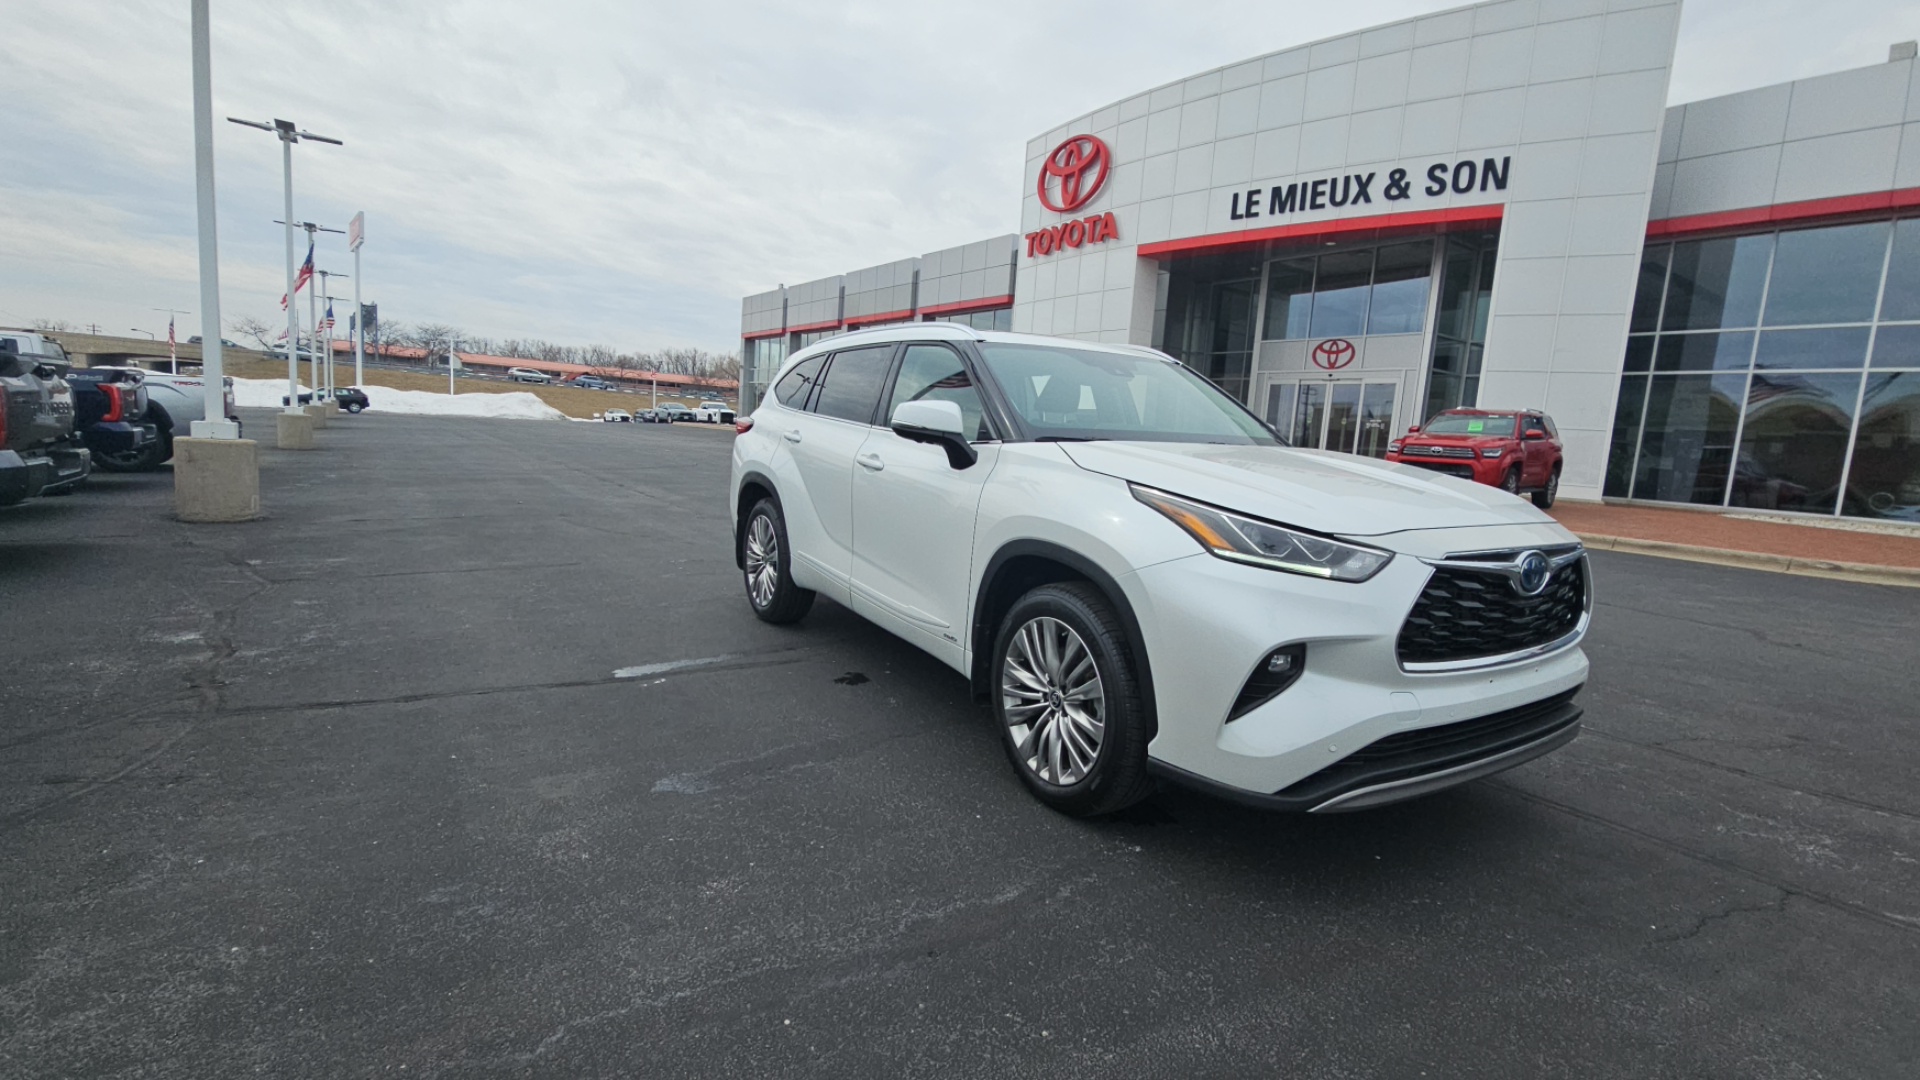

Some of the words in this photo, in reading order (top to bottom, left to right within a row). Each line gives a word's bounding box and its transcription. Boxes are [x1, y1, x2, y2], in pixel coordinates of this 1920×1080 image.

[1230, 189, 1262, 220] LE
[1269, 172, 1376, 216] MIEUX
[1383, 167, 1412, 202] &
[1425, 156, 1511, 197] SON
[1025, 211, 1119, 258] TOYOTA
